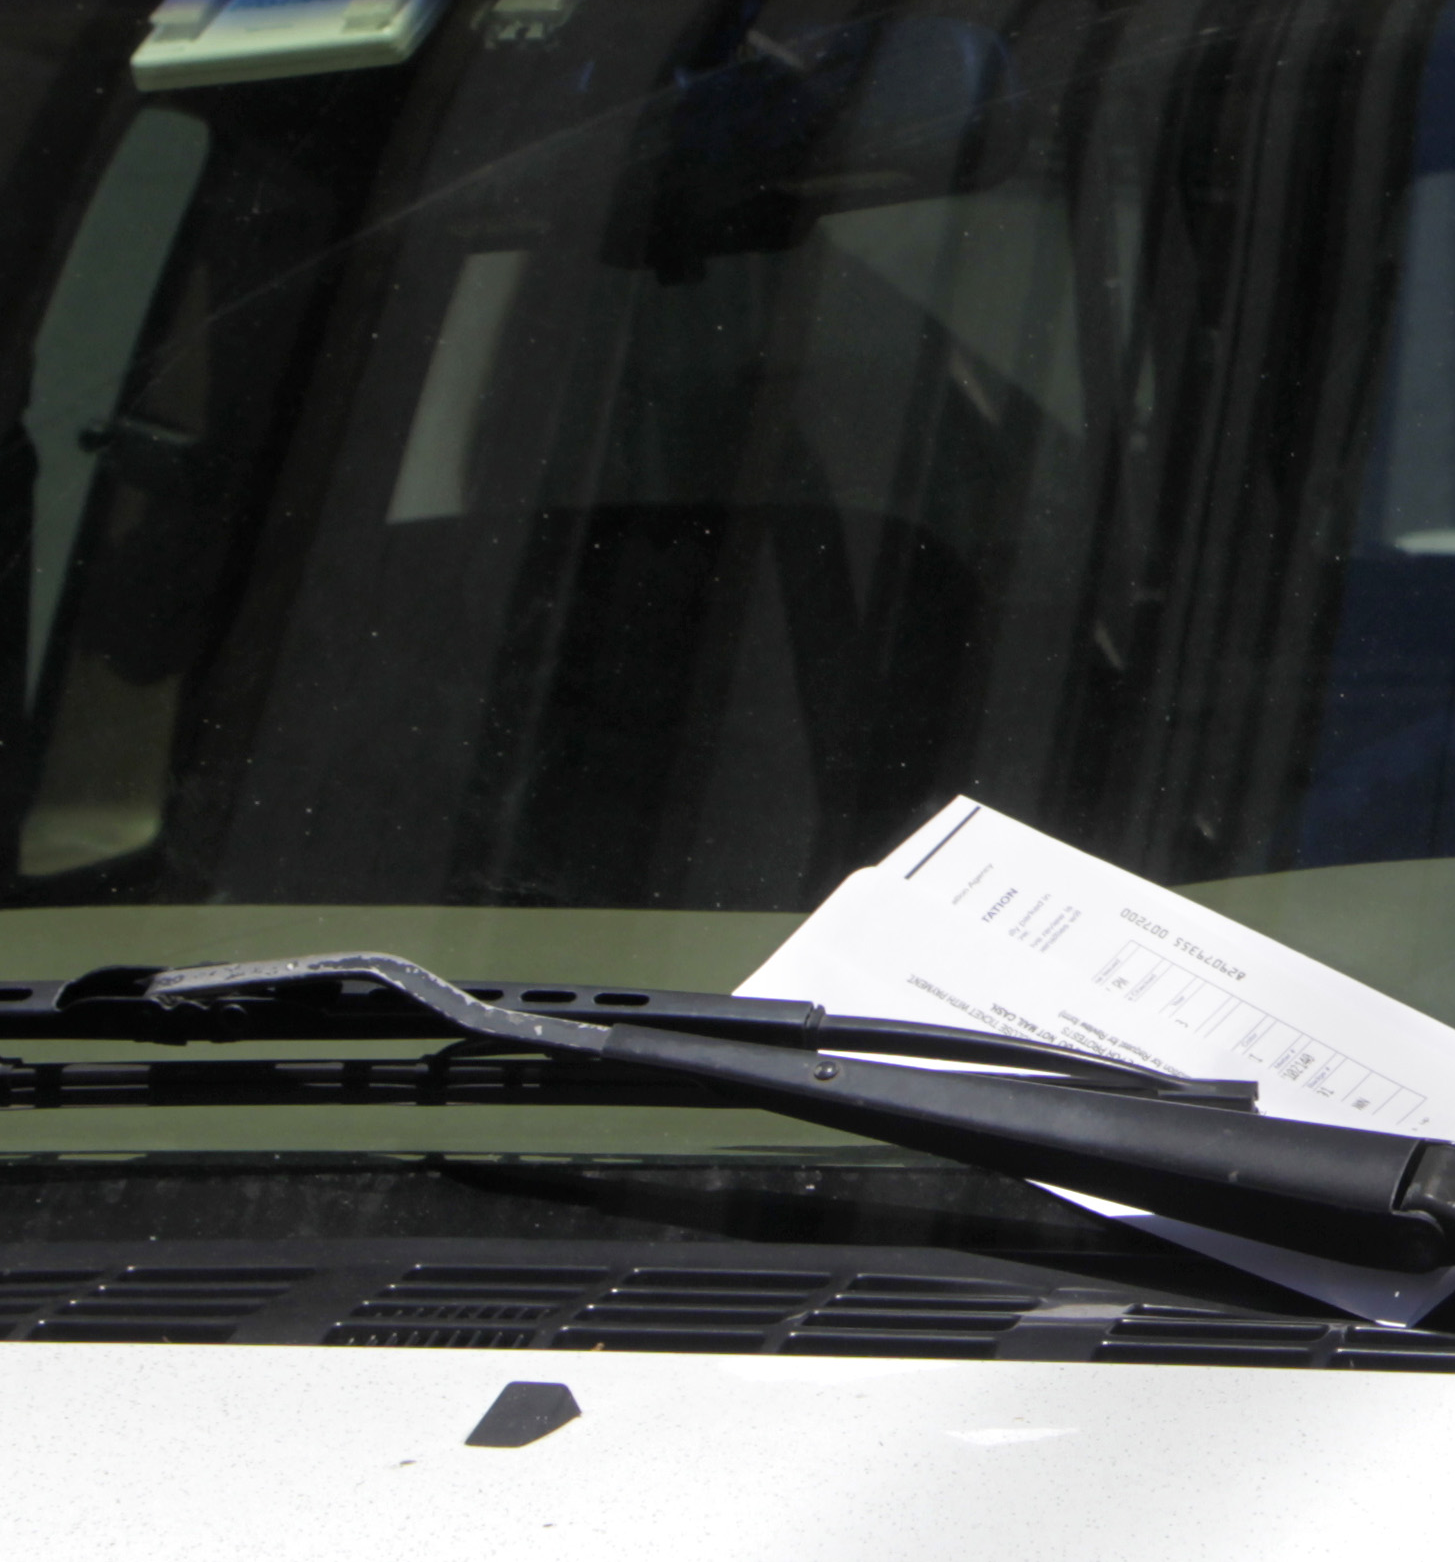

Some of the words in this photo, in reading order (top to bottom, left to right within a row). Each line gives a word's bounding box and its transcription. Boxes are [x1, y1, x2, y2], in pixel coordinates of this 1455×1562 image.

[981, 887, 1018, 924] TATION
[1119, 907, 1169, 939] 007200
[1173, 936, 1247, 981] 829079355
[945, 994, 970, 1012] WITH
[967, 1007, 1001, 1029] TICKET
[1016, 1016, 1039, 1034] MAIL
[1035, 1028, 1057, 1043] NOT
[1060, 1026, 1107, 1056] PROTESTS
